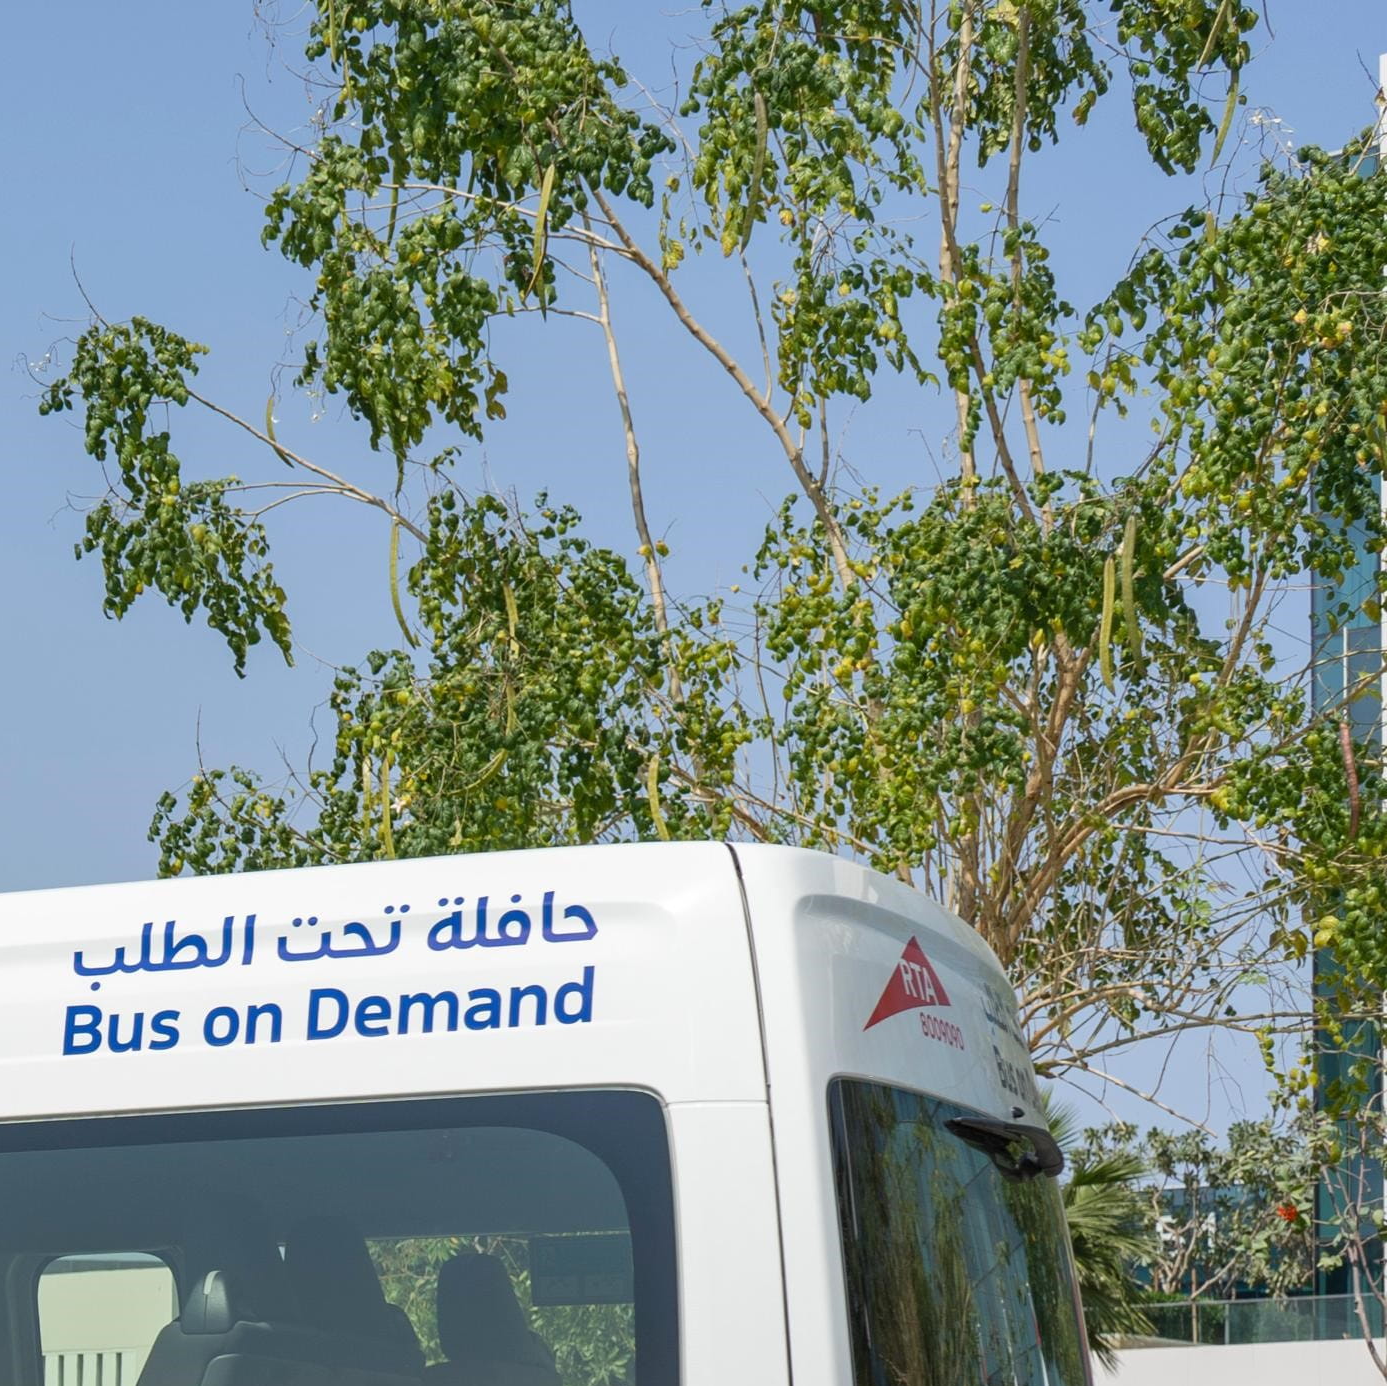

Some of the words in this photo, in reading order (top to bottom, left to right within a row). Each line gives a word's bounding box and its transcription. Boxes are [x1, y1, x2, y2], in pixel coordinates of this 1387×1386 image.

[278, 904, 402, 961] تحت
[428, 890, 597, 952] حافلة
[73, 914, 254, 991] الطلب
[61, 1003, 181, 1056] Bus
[203, 1003, 283, 1046] on
[307, 965, 595, 1041] Demand
[899, 959, 939, 1006] RTA
[920, 1012, 965, 1051] 8009090
